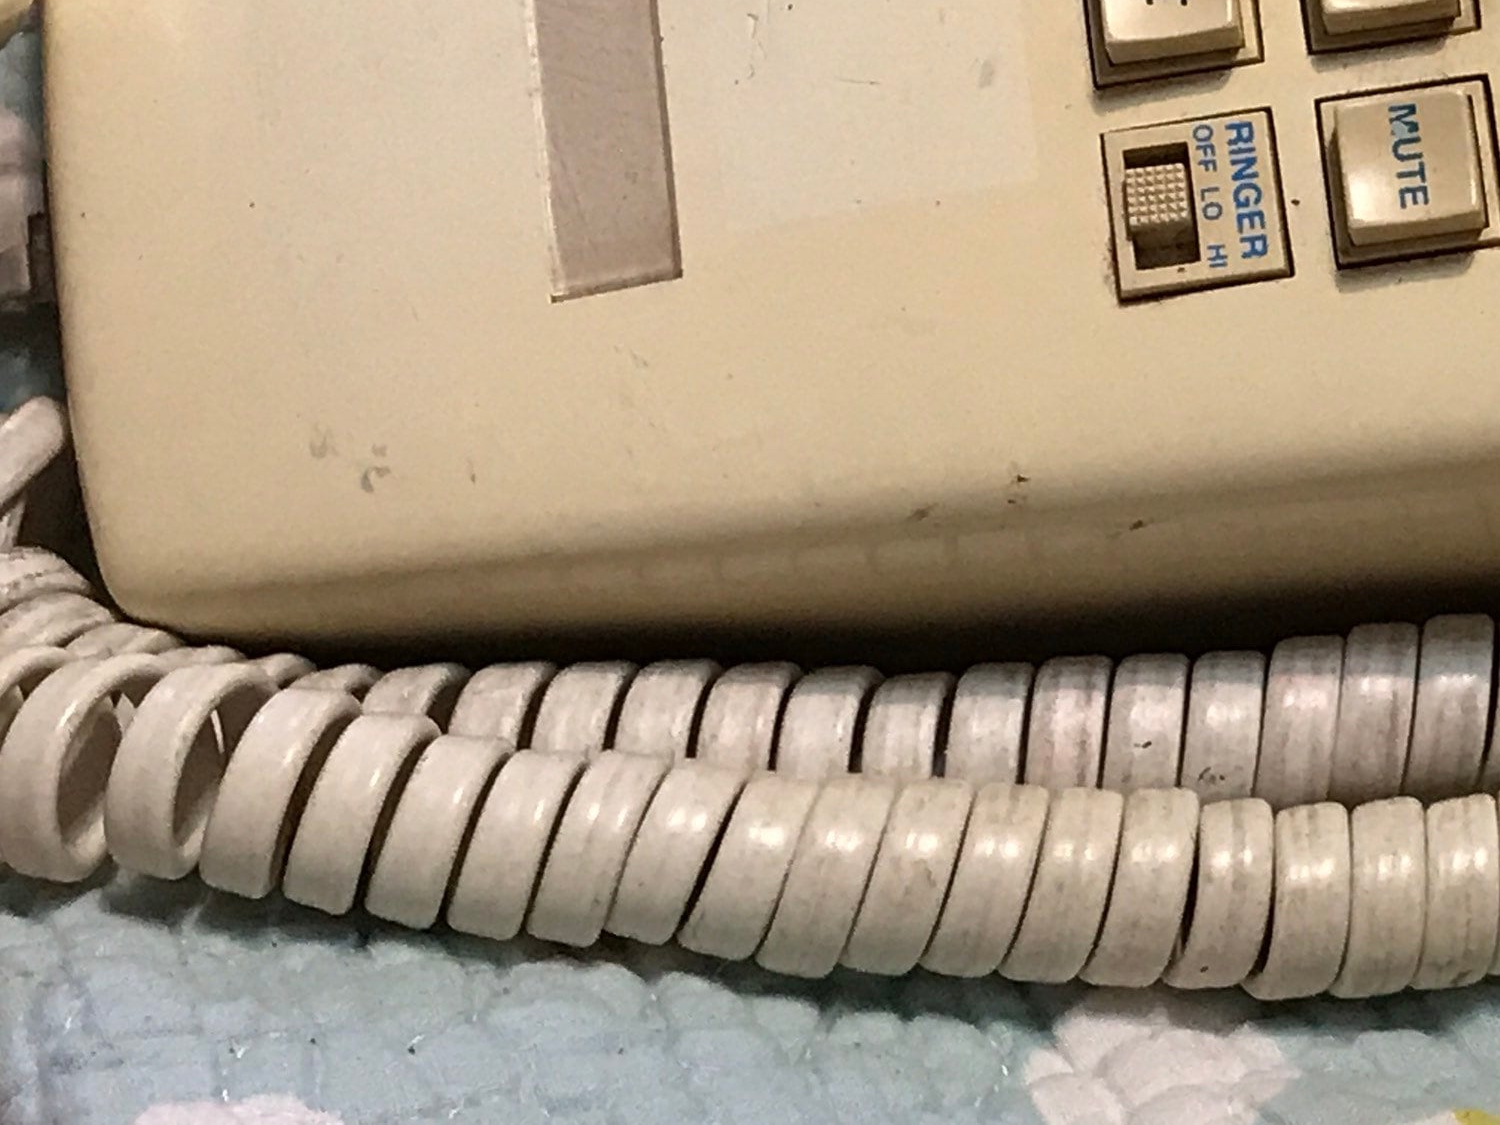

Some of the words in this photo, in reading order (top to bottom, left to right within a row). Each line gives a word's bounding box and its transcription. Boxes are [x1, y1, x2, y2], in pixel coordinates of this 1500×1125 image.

[1192, 124, 1217, 173] OFF
[1387, 102, 1430, 210] MUTE
[1200, 186, 1224, 221] LO
[1224, 120, 1269, 260] RINGER
[1206, 243, 1228, 269] HI
